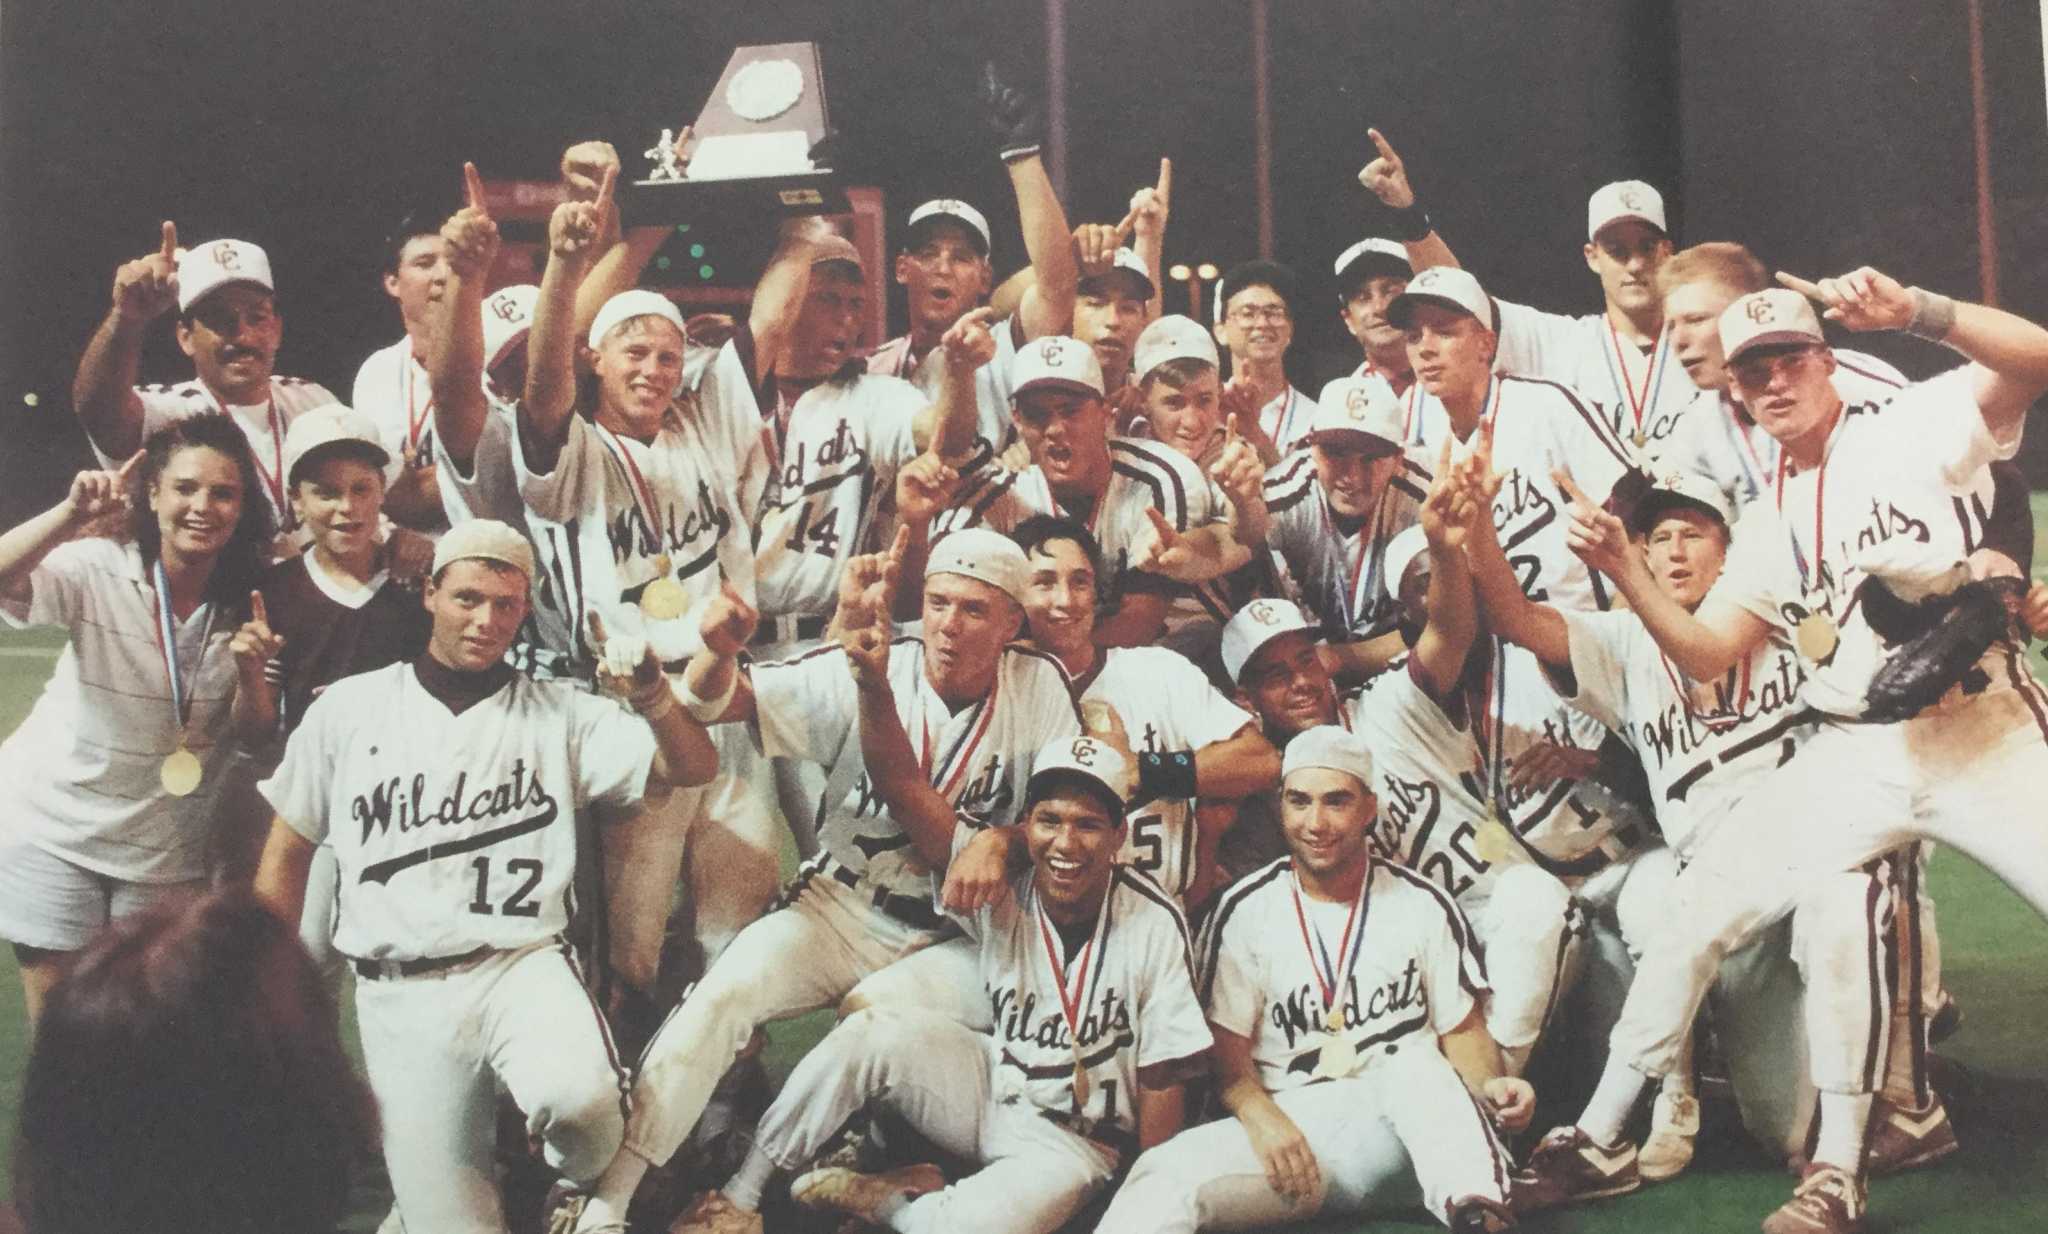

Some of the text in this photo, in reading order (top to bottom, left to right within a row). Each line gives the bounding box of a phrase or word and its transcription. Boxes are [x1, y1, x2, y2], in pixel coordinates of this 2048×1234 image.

[212, 241, 241, 272] CC
[489, 294, 525, 325] CC
[1746, 295, 1776, 324] CC
[1041, 338, 1064, 368] CC
[1346, 387, 1370, 421] CC
[784, 501, 840, 560] 14
[1249, 601, 1281, 627] CC
[1071, 737, 1098, 767] CC
[351, 758, 550, 847] Wildcats
[468, 855, 544, 918] 12
